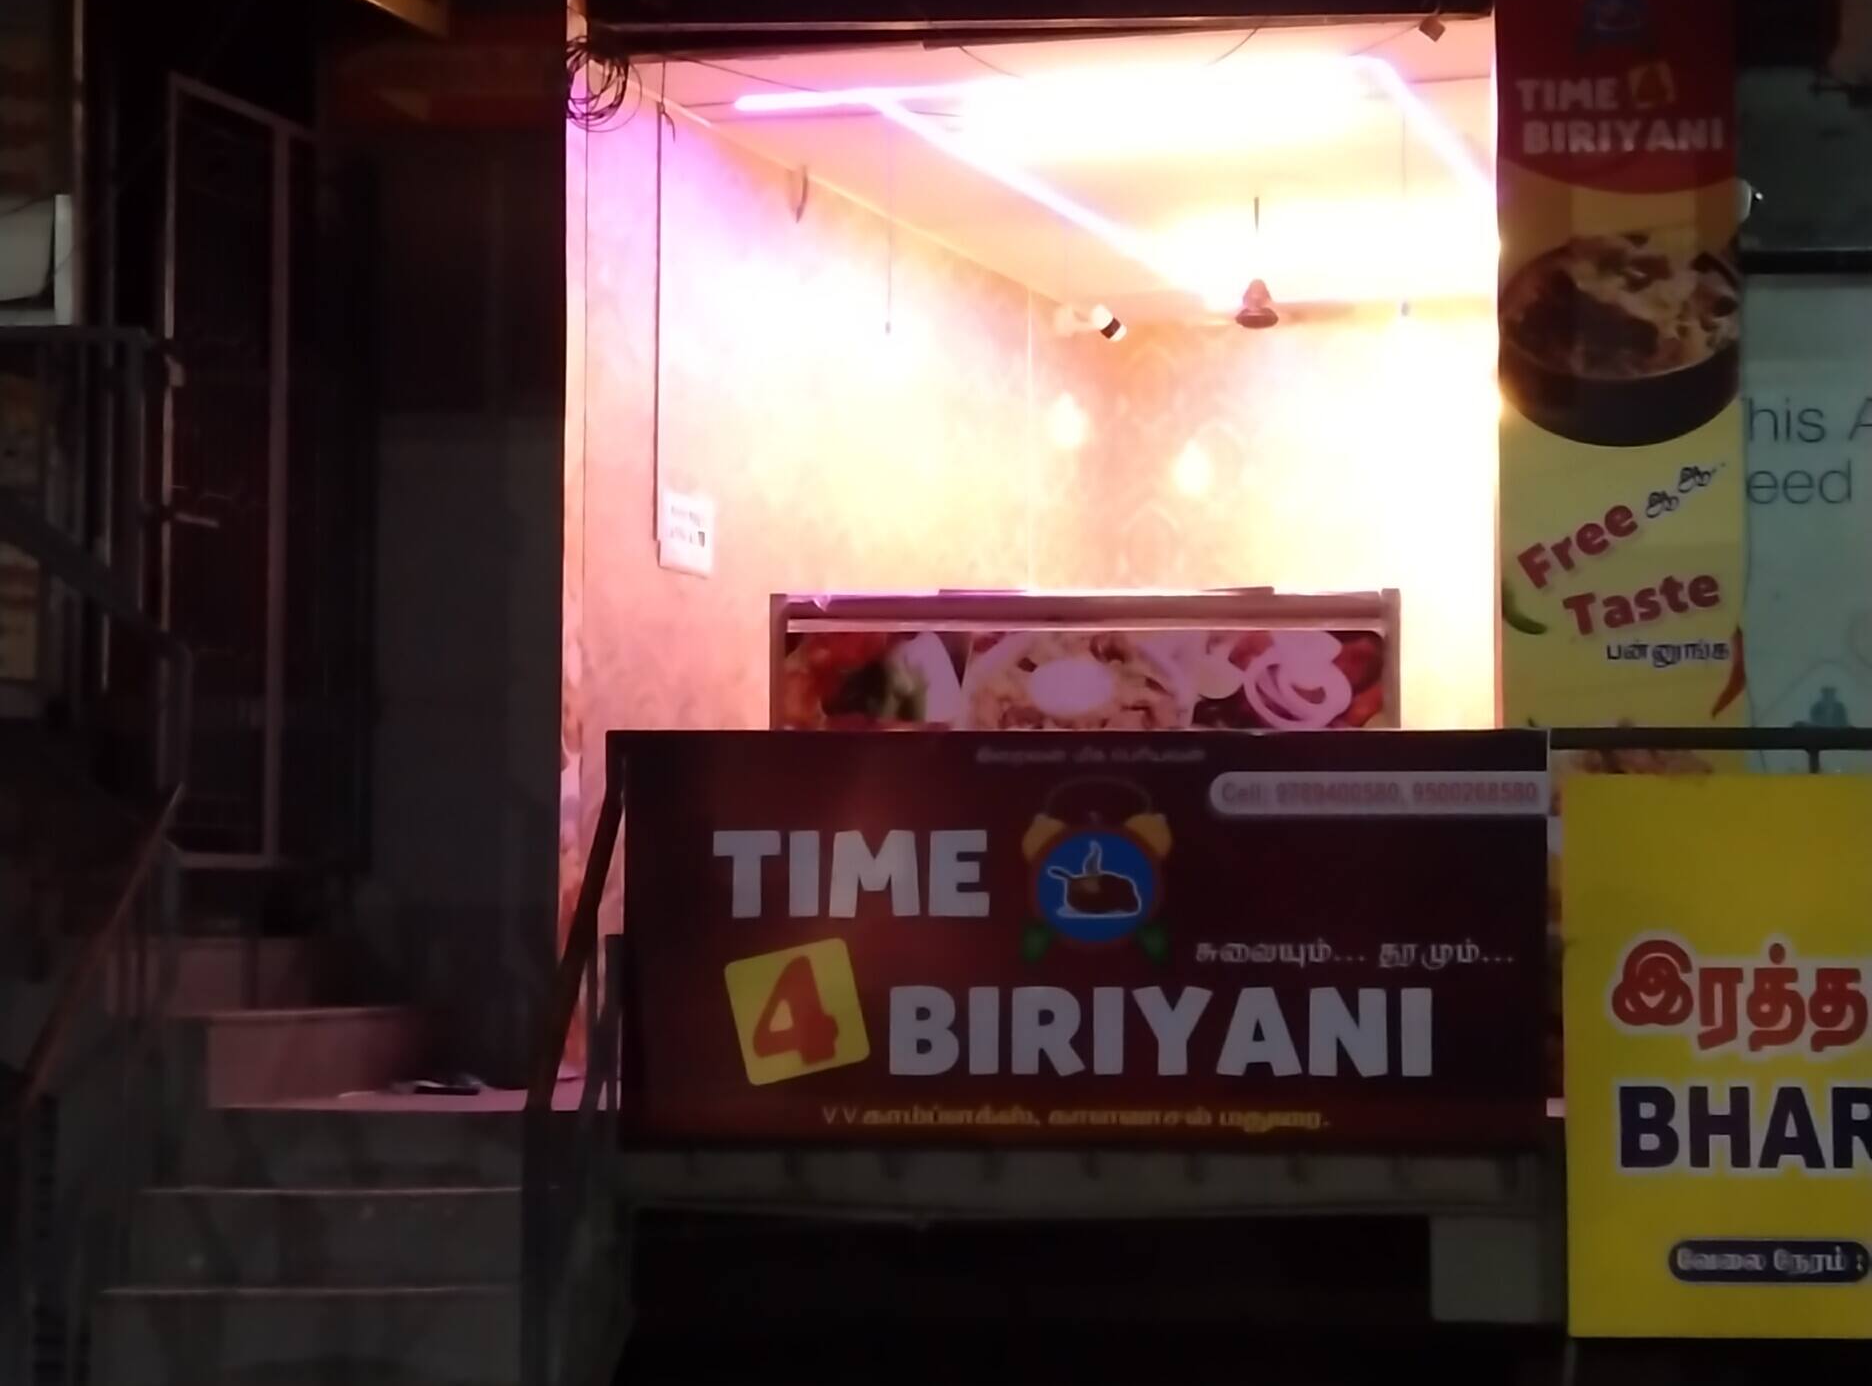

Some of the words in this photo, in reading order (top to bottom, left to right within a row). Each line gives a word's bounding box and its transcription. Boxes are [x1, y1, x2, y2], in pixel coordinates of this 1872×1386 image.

[1516, 78, 1618, 113] TIME
[1523, 117, 1725, 155] BIRIYANI
[1741, 397, 1827, 444] his
[1518, 505, 1638, 590] Free
[1563, 574, 1721, 636] Taste
[713, 829, 990, 918] TIME
[753, 955, 839, 1065] 4
[889, 985, 1433, 1077] BIRIYANI
[1612, 939, 1869, 1053] இரத்த
